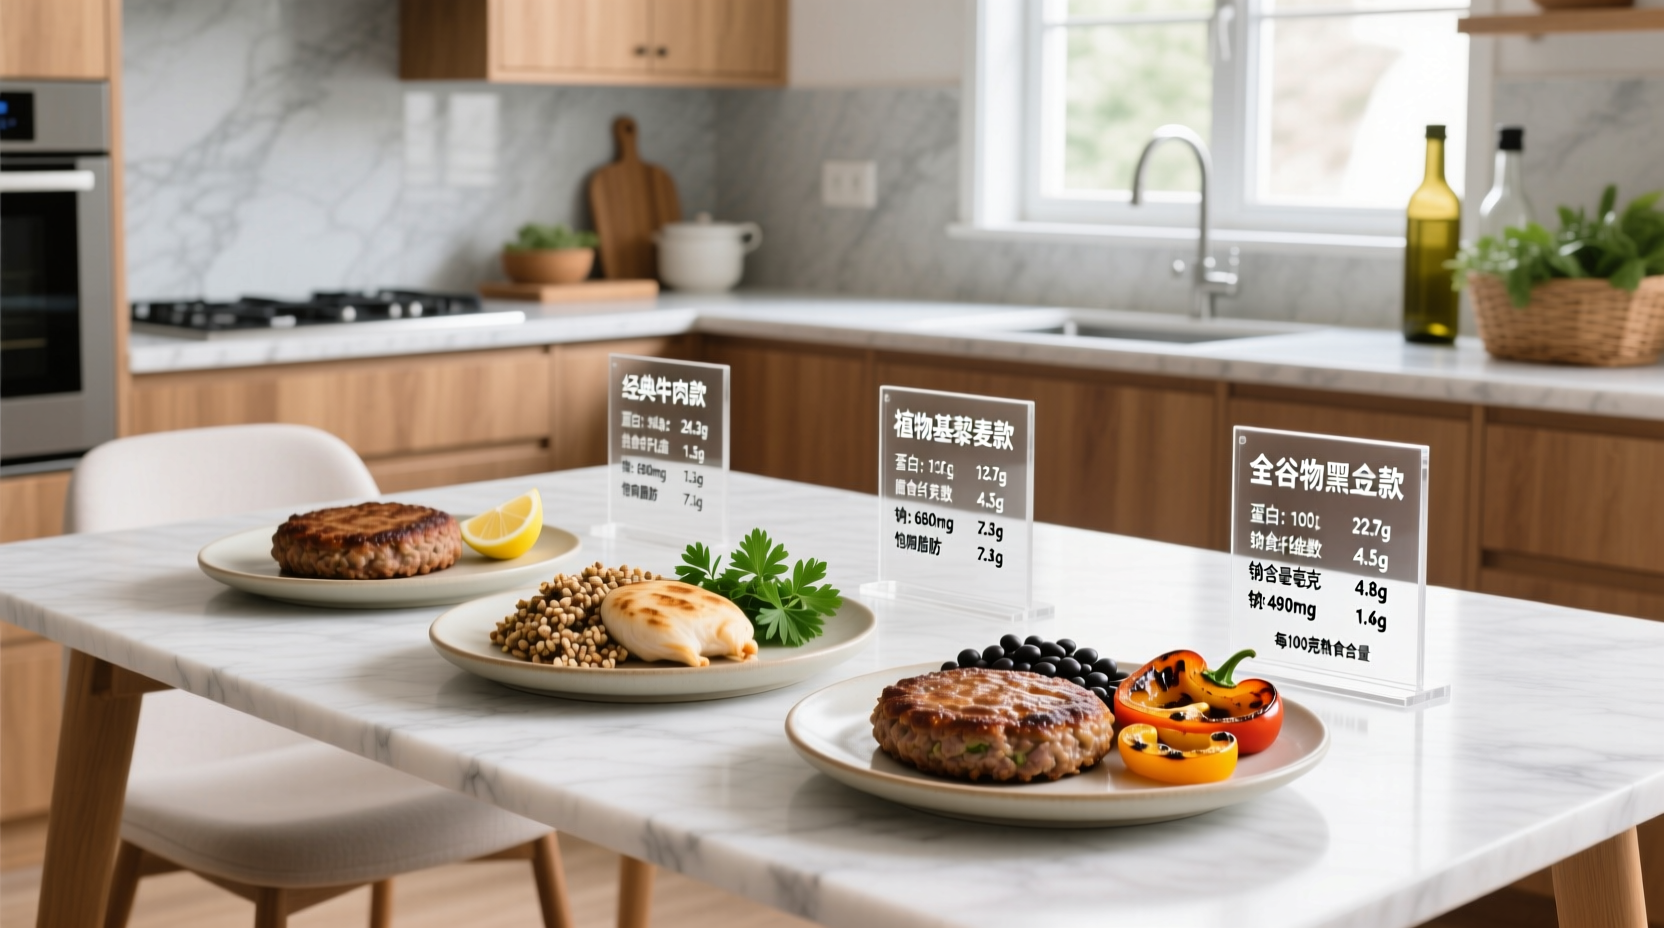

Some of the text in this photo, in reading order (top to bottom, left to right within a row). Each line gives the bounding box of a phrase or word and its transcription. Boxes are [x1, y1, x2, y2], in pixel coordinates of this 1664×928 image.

[621, 373, 707, 408] 经典牛肉款
[976, 491, 1004, 513] 4.5g
[977, 520, 1004, 542] 7.3g
[1352, 517, 1391, 543] 22.7g
[1353, 547, 1389, 573] 4.5g
[1354, 579, 1388, 604] 4.8g
[1267, 594, 1317, 621] 490mg
[1356, 608, 1387, 633] 1.6g
